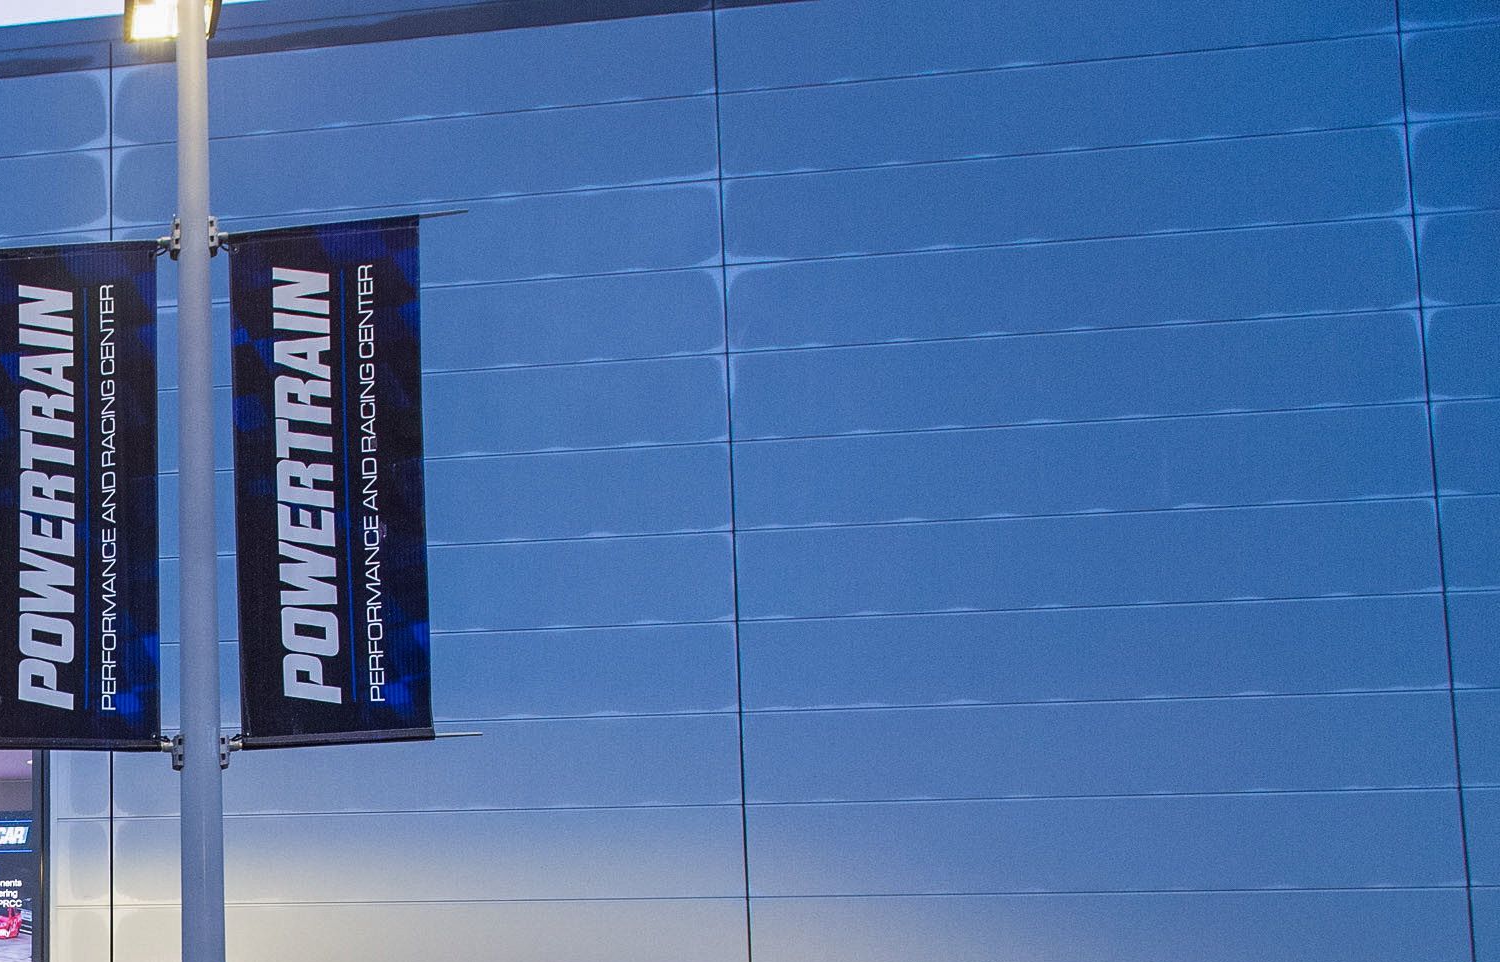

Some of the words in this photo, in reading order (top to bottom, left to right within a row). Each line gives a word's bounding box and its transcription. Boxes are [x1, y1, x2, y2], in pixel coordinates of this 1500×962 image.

[99, 284, 115, 376] CENTER
[357, 264, 375, 359] CENTER
[100, 380, 116, 468] RACING
[359, 363, 377, 453] RACING
[17, 284, 75, 711] POWERTRAIN
[101, 471, 117, 524] AND
[272, 266, 342, 704] POWERTRAIN
[361, 457, 379, 512] AND
[101, 528, 117, 711] PERFORMANCE
[363, 515, 386, 702] PERFORMANCE
